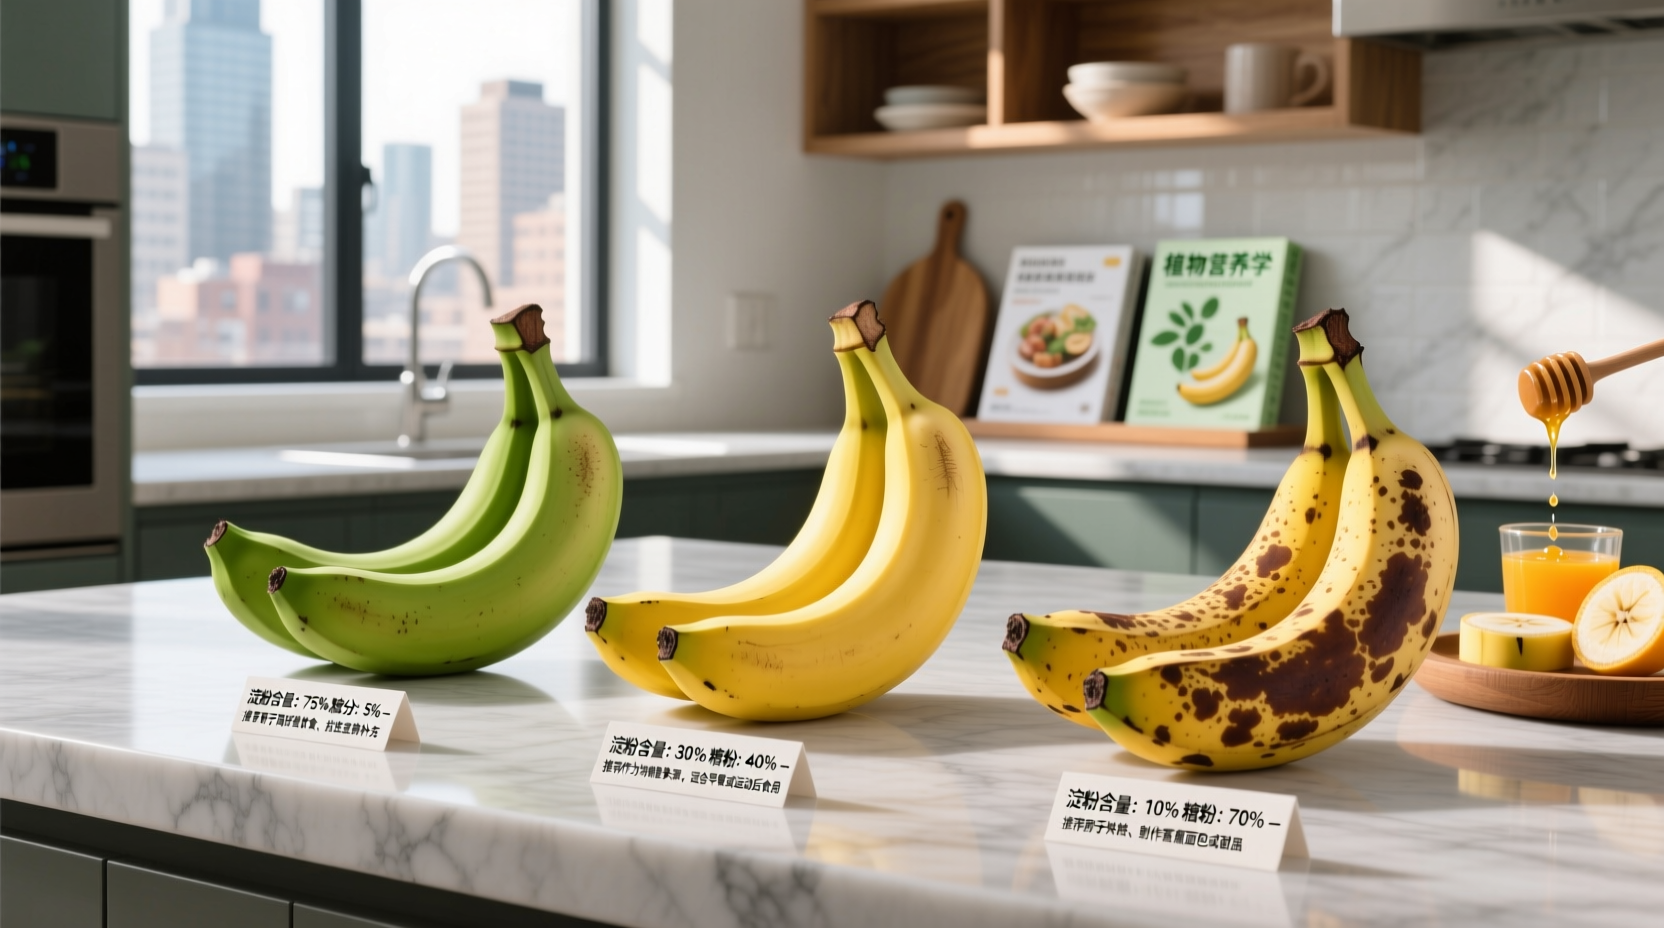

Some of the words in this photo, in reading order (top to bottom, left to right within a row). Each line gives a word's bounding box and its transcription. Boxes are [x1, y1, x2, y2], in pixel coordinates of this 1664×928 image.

[1164, 252, 1272, 277] 植物营养学
